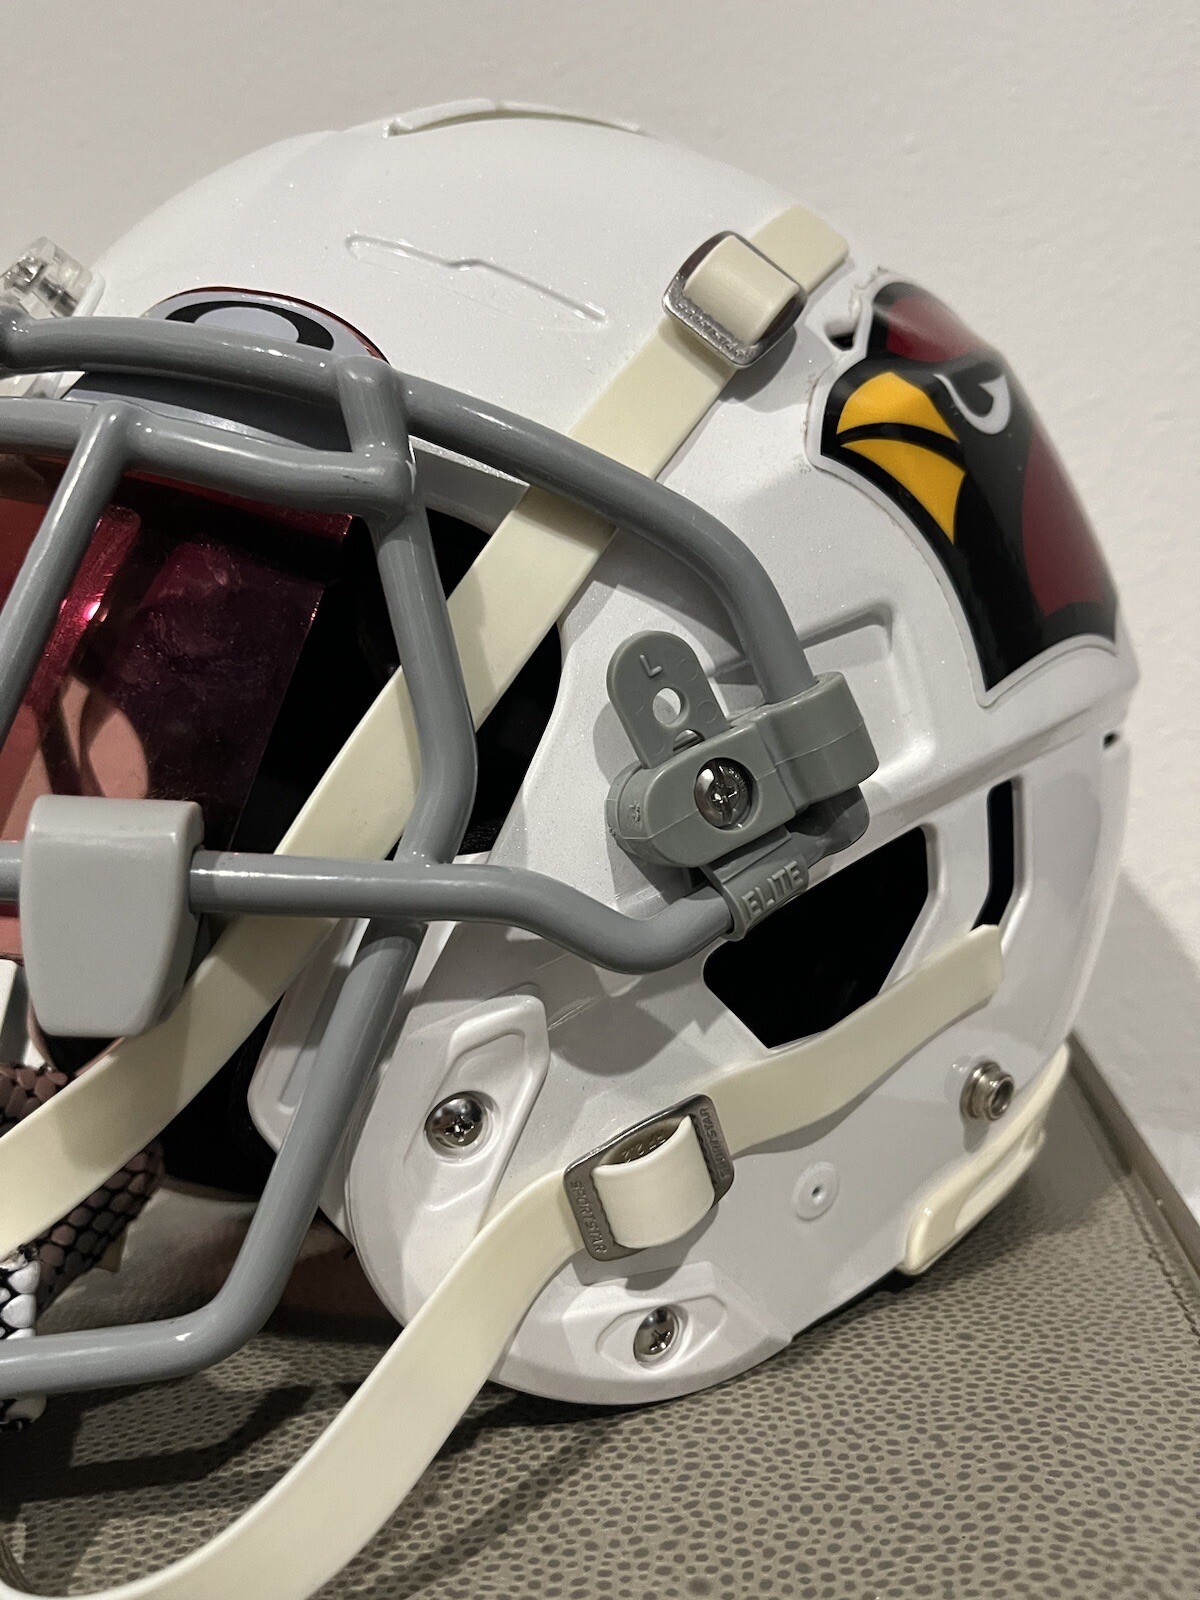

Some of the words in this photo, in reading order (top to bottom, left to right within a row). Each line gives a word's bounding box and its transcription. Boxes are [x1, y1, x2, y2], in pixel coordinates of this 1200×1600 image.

[639, 654, 662, 677] L
[741, 860, 804, 919] ELITE
[569, 1181, 608, 1254] SPORTSTAR
